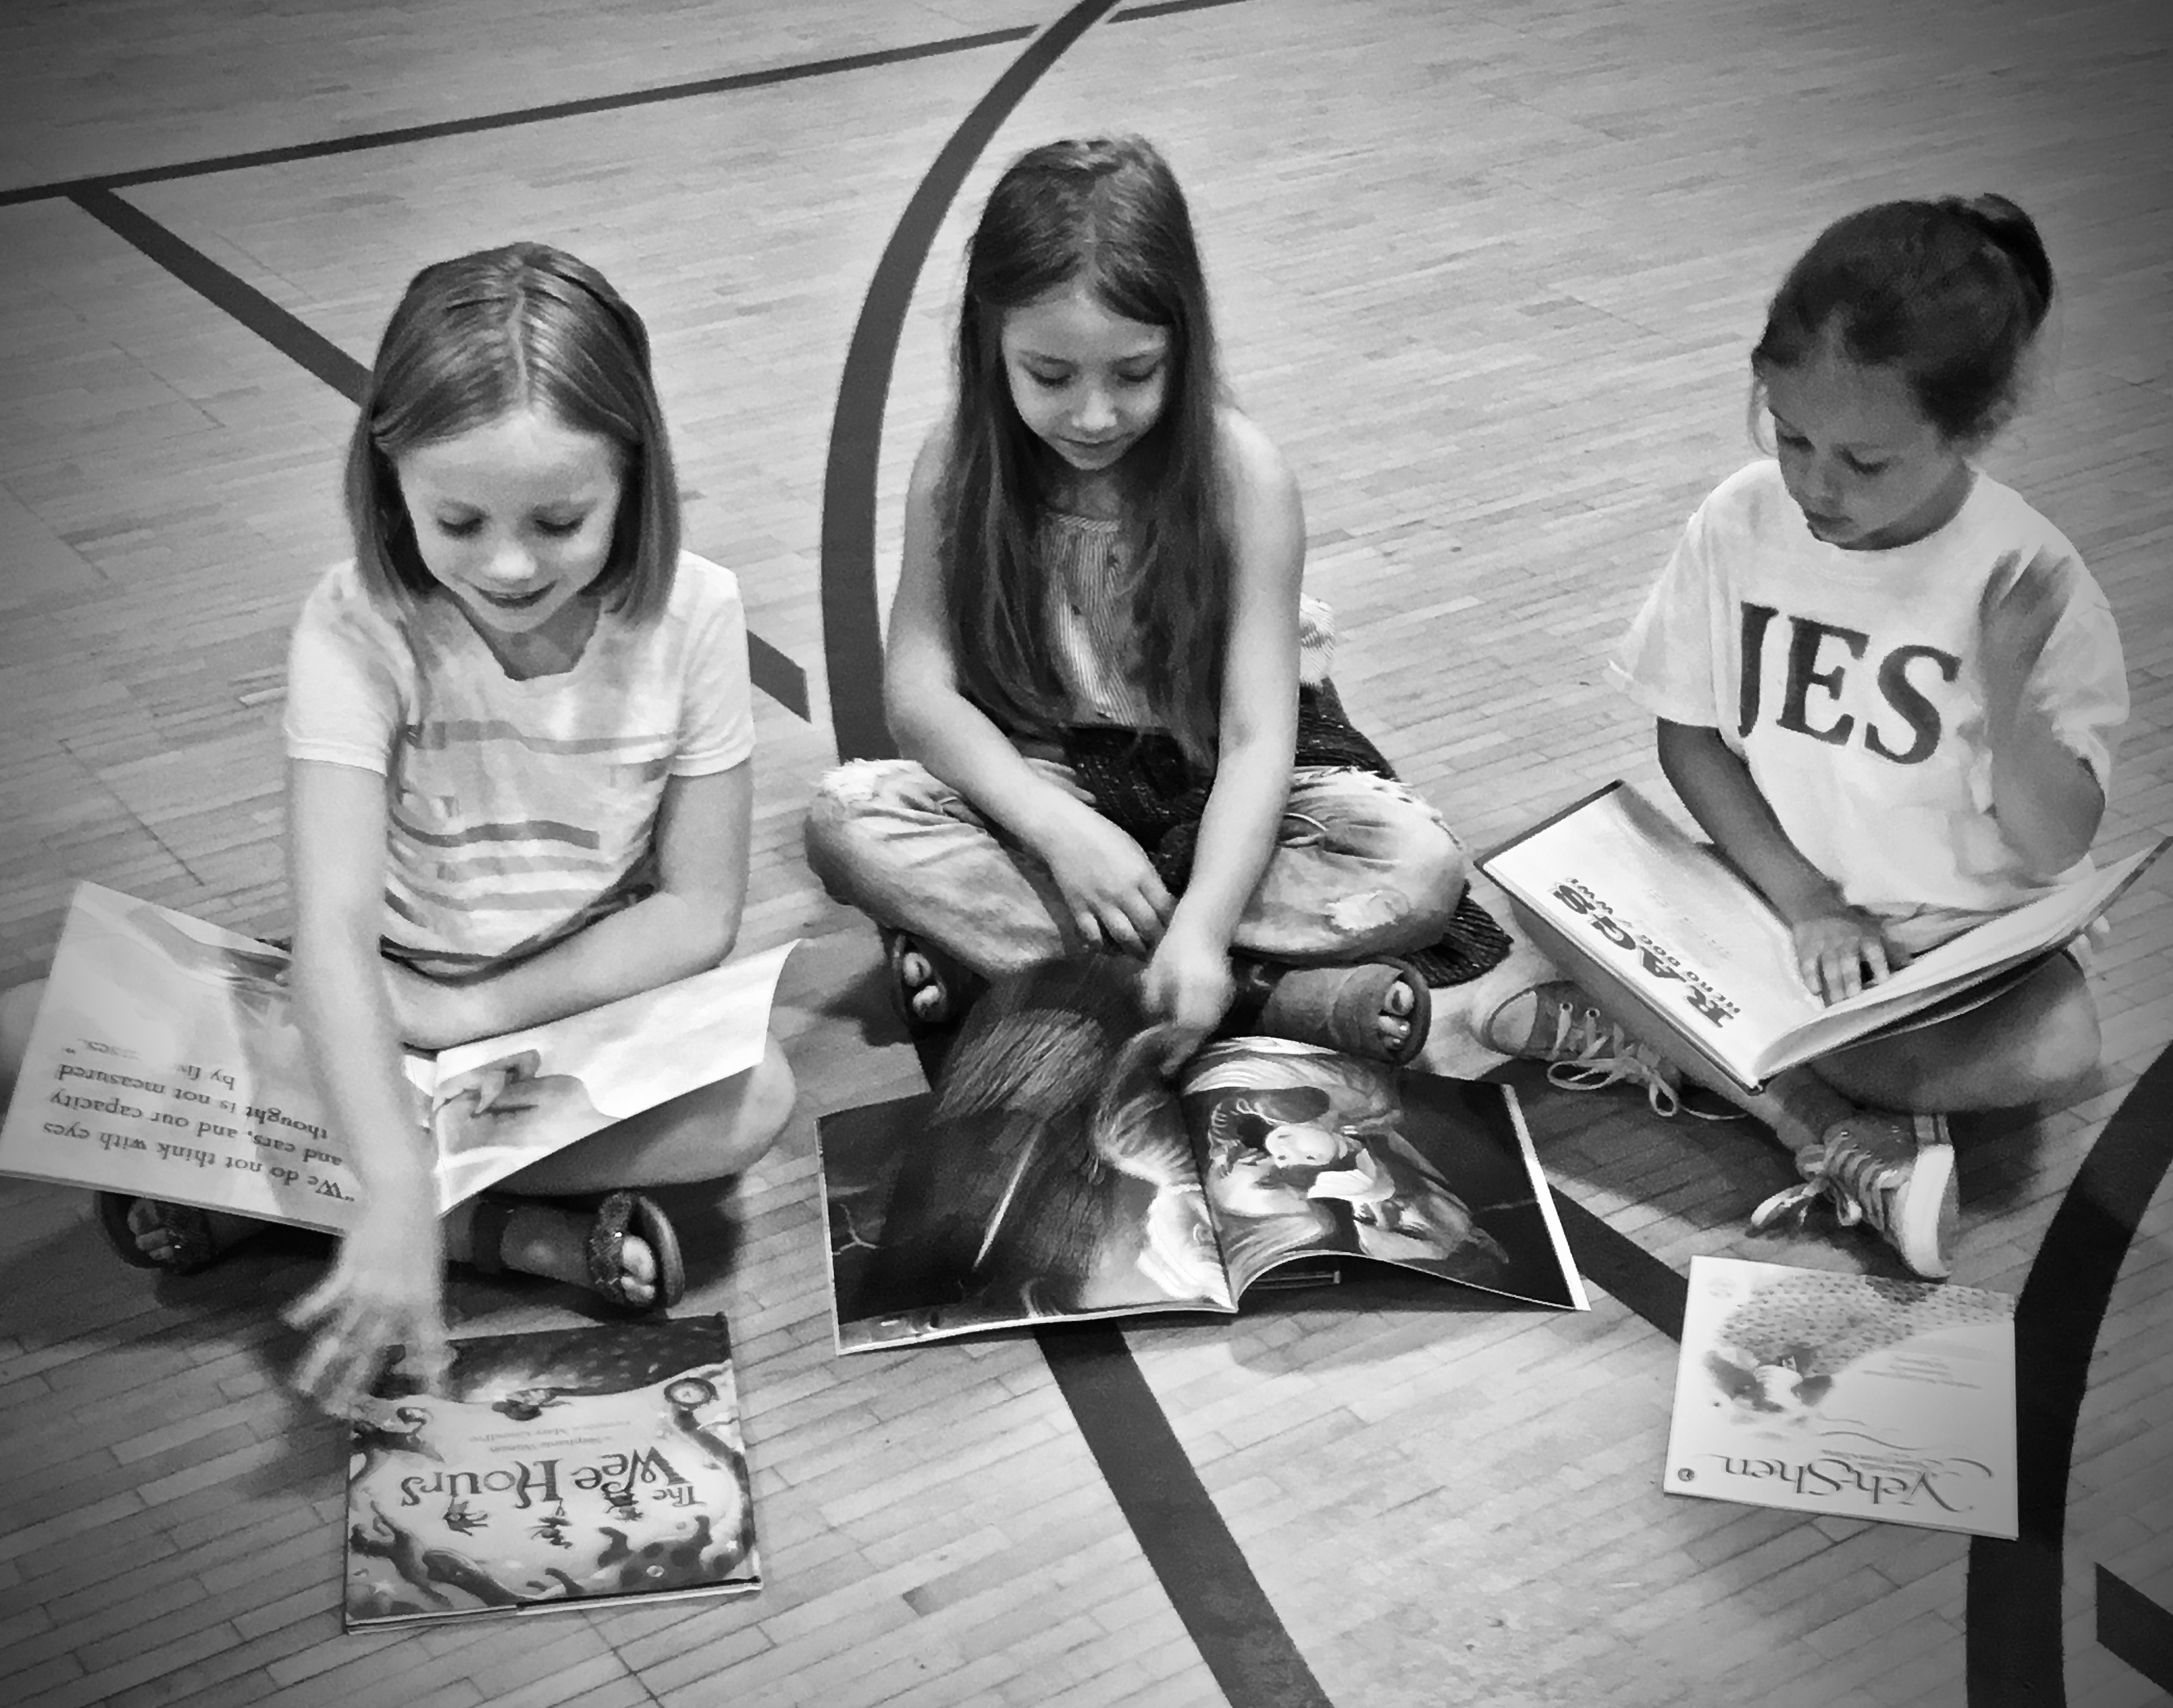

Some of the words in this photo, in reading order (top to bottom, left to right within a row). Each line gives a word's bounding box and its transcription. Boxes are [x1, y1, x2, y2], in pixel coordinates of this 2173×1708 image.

[1738, 600, 1962, 764] JES
[1551, 883, 1734, 1027] RAGS
[58, 1063, 166, 1095] measured
[210, 1068, 235, 1090] by
[50, 1088, 143, 1122] capacity
[172, 1088, 211, 1105] not
[219, 1099, 236, 1114] is
[151, 1111, 190, 1128] our
[197, 1121, 238, 1139] and
[246, 1105, 329, 1141] thought
[43, 1121, 90, 1141] eyes
[100, 1132, 147, 1152] with
[247, 1130, 296, 1153] ears,
[157, 1142, 216, 1167] think
[226, 1156, 263, 1174] not
[303, 1148, 342, 1167] and
[269, 1165, 299, 1186] do
[571, 1446, 691, 1493] Wee
[400, 1458, 563, 1509] Hours
[1696, 1454, 1992, 1513] Yeh-Shen
[652, 1485, 706, 1507] The
